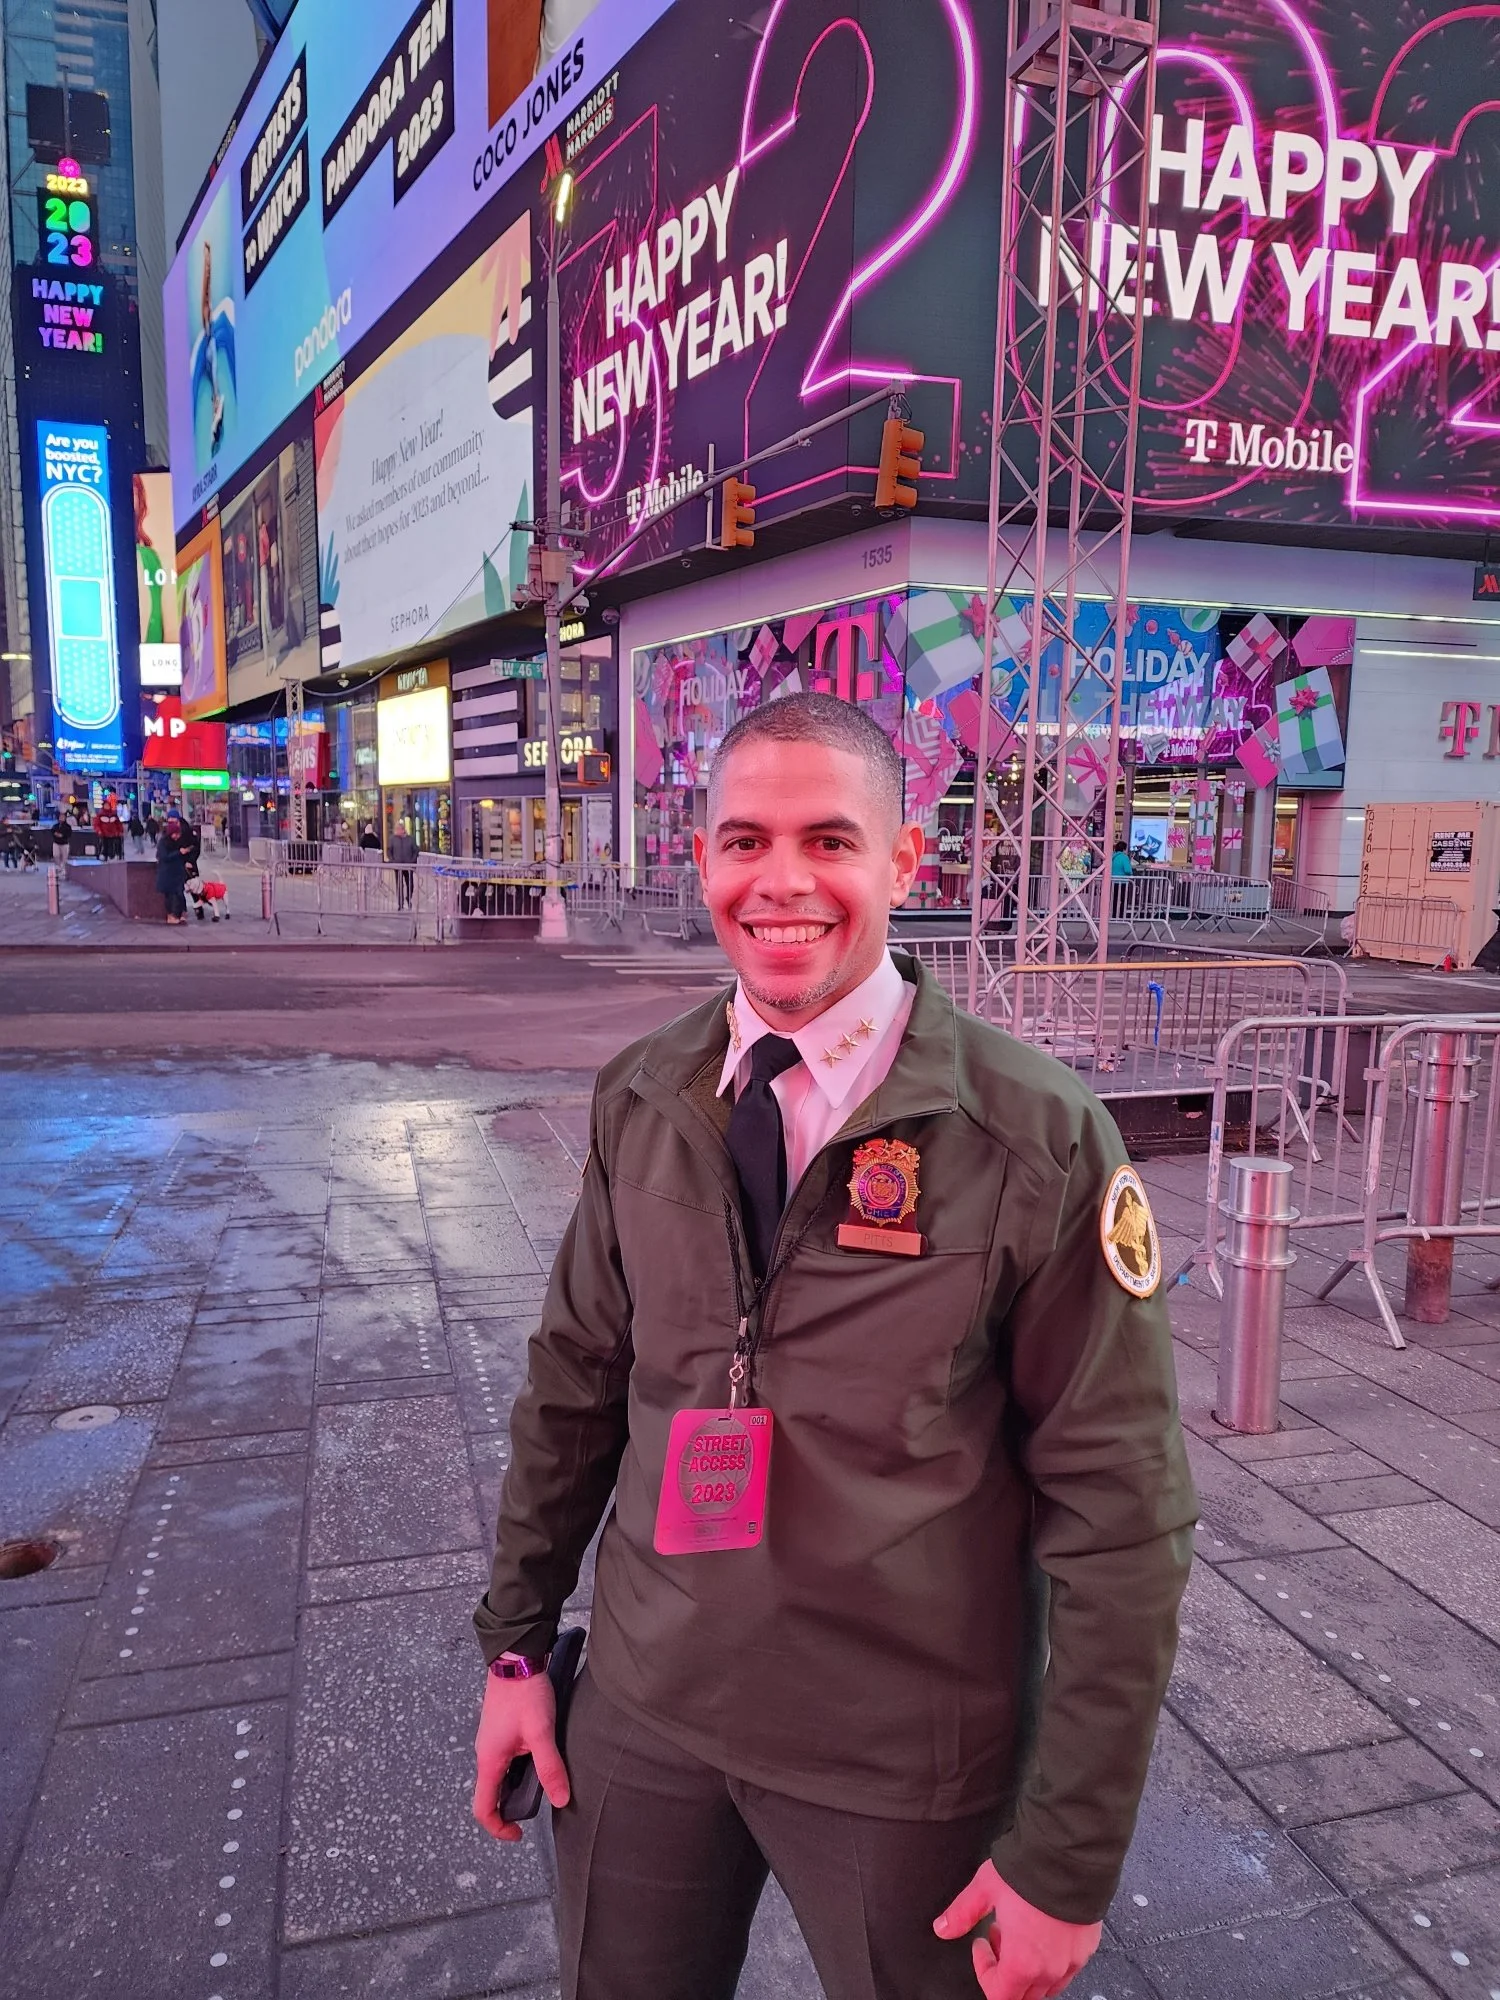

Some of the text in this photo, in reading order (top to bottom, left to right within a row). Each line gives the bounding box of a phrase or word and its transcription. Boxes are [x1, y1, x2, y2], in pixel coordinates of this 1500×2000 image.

[326, 0, 447, 206] PANDORA TEN
[473, 37, 584, 191] COCO JONES
[566, 71, 620, 139] MARRIOTT
[249, 68, 301, 201] ARTISTS
[397, 79, 444, 178] 2023
[566, 102, 613, 161] MARQUIS
[46, 174, 88, 193] 2023
[1148, 113, 1436, 235] HAPPY
[246, 149, 303, 273] TO WATCH
[605, 164, 739, 340] HAPPY
[1038, 214, 1255, 325] NEW
[32, 278, 104, 305] HAPPY
[43, 304, 94, 327] NEW
[38, 327, 103, 353] YEAR!
[294, 286, 352, 388] pandora
[573, 238, 788, 444] NEW YEAR!
[46, 433, 99, 452] Are you
[372, 408, 443, 486] Happy New Year!
[46, 461, 103, 484] NYC?
[418, 466, 431, 488] our
[433, 430, 484, 477] community
[430, 483, 446, 514] and
[862, 545, 892, 569] 1535
[391, 604, 429, 633] SEPHORA
[504, 662, 514, 676] W
[518, 663, 533, 676] 46
[1070, 646, 1210, 683] HOLIDAY
[680, 668, 748, 706] HOLIDAY
[524, 736, 593, 767] SEPORA
[866, 1208, 898, 1218] CHIEF
[864, 1233, 893, 1247] PITTS
[1113, 1255, 1145, 1289] DEPARTMENT
[751, 1416, 765, 1425] 001
[694, 1434, 748, 1452] STREET
[689, 1453, 746, 1473] ACCESS
[691, 1481, 736, 1504] 2023
